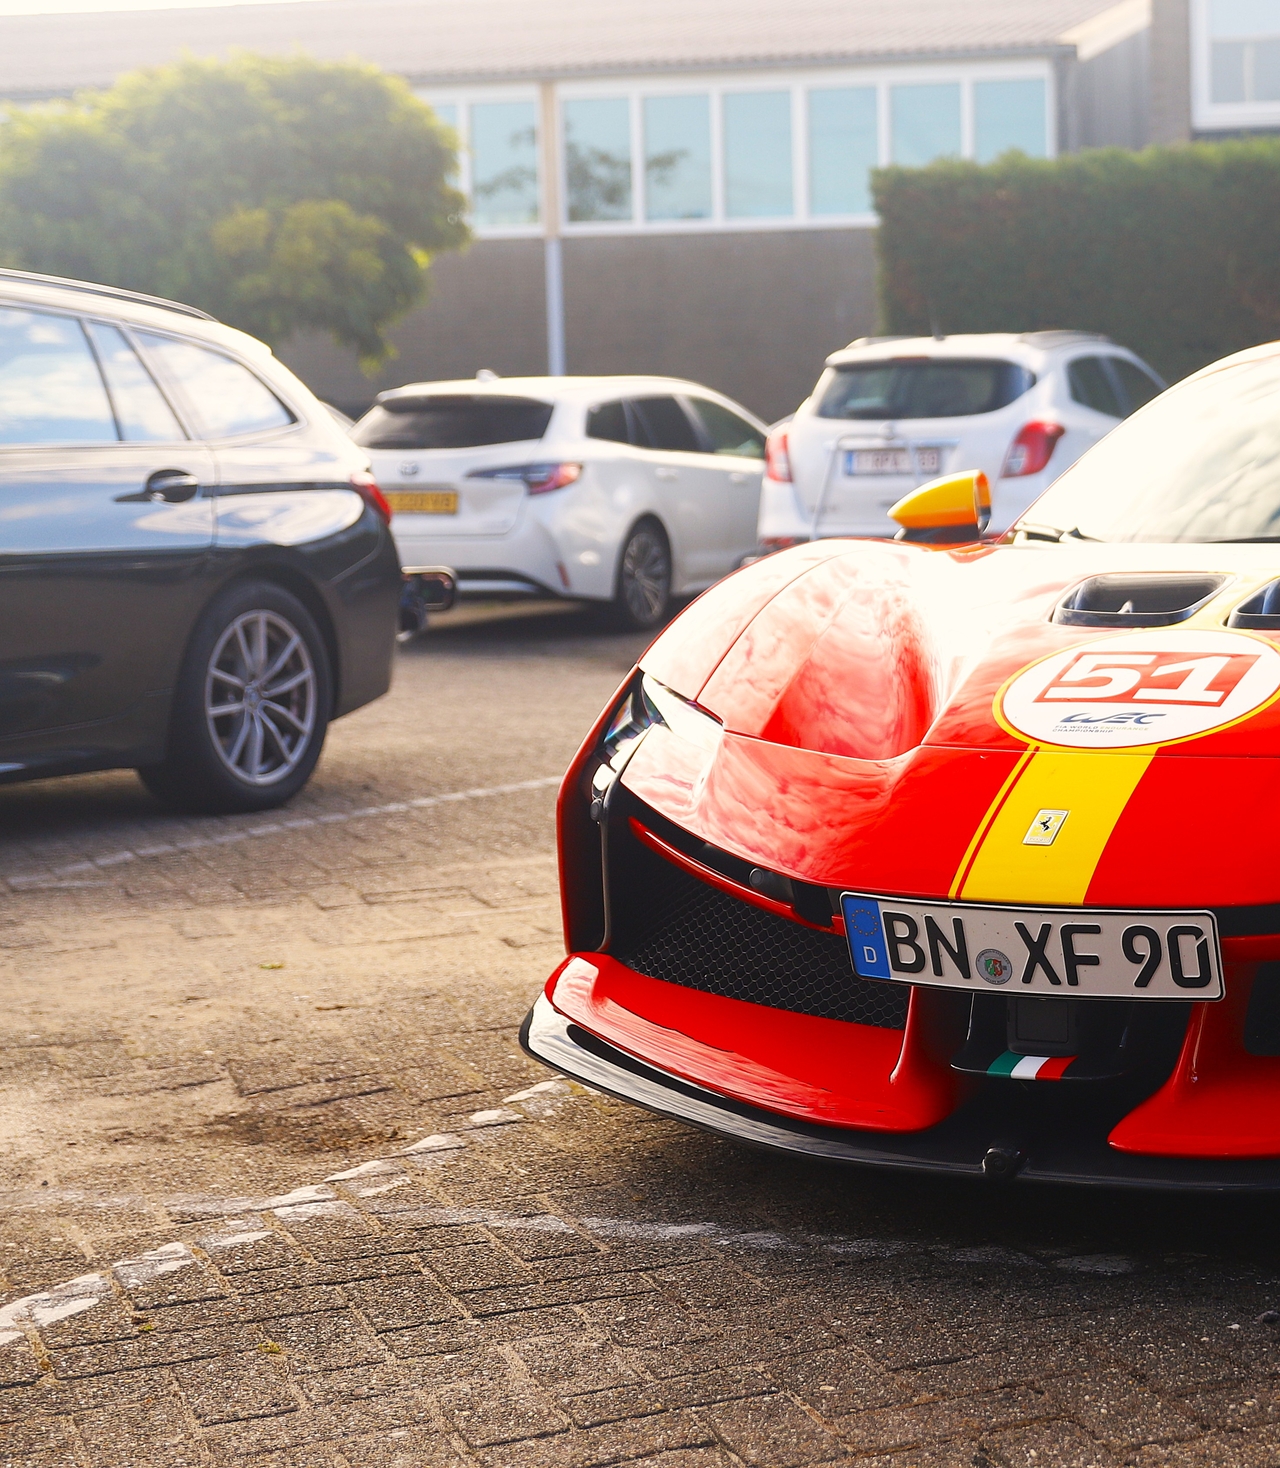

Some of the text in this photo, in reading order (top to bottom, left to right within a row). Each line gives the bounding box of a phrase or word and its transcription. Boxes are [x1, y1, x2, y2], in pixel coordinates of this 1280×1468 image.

[1043, 654, 1233, 703] 51
[1060, 712, 1167, 725] WEC
[863, 945, 877, 963] D
[882, 911, 1212, 988] BN XF 90
